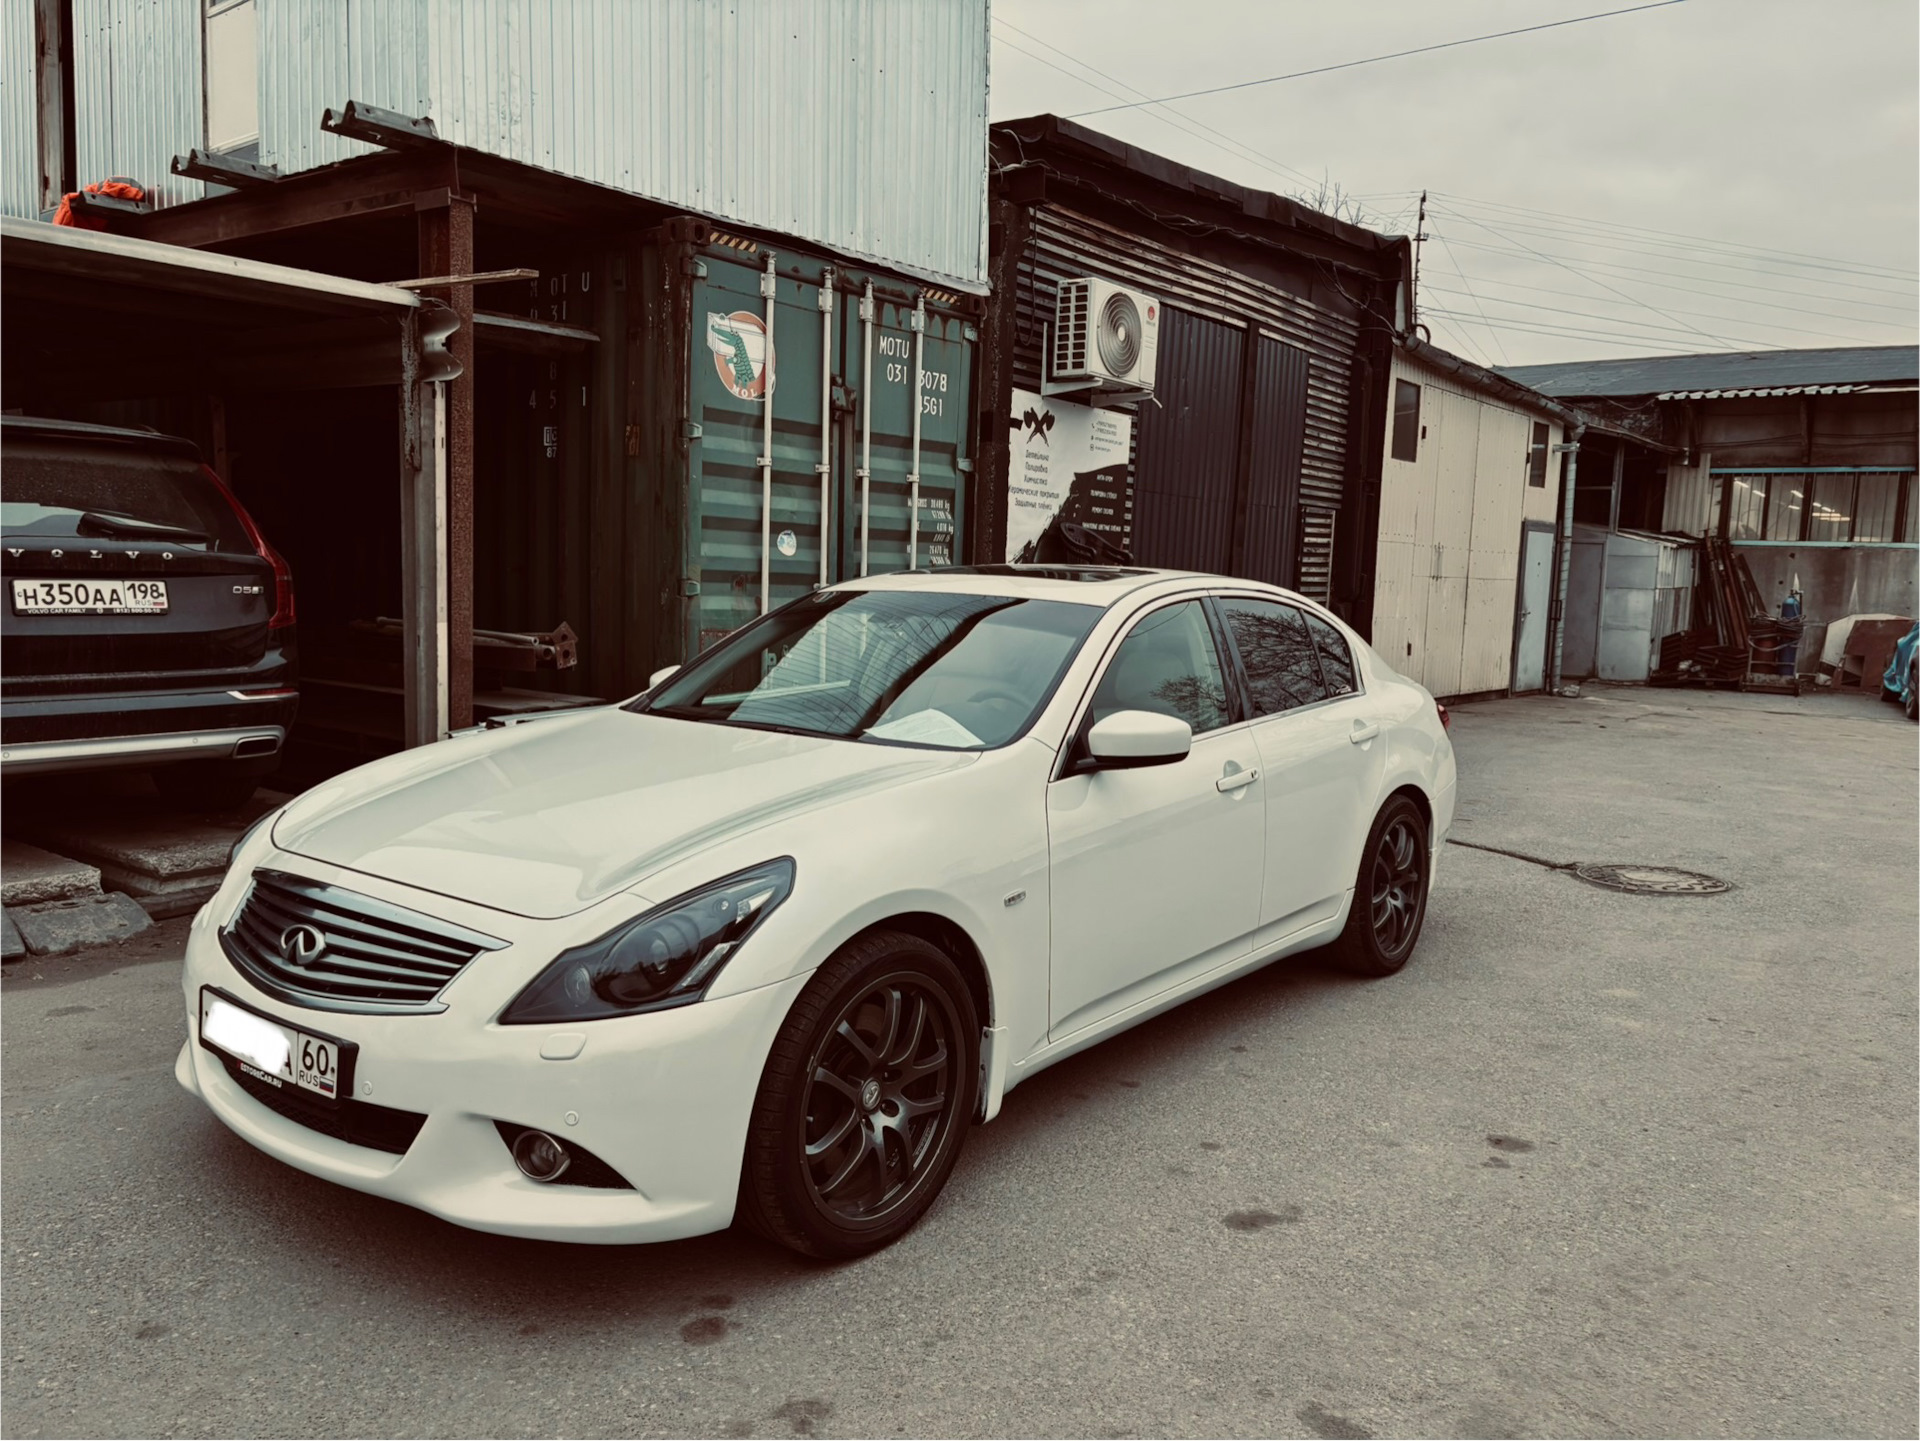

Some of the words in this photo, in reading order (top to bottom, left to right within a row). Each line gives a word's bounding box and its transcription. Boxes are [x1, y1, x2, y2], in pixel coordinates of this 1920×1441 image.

[879, 335, 910, 359] MOTU
[886, 363, 908, 385] 031
[731, 383, 758, 398] MOL
[8, 549, 173, 560] VOLVO
[126, 583, 160, 600] 198
[303, 1040, 328, 1075] 60
[299, 1070, 319, 1087] RUS
